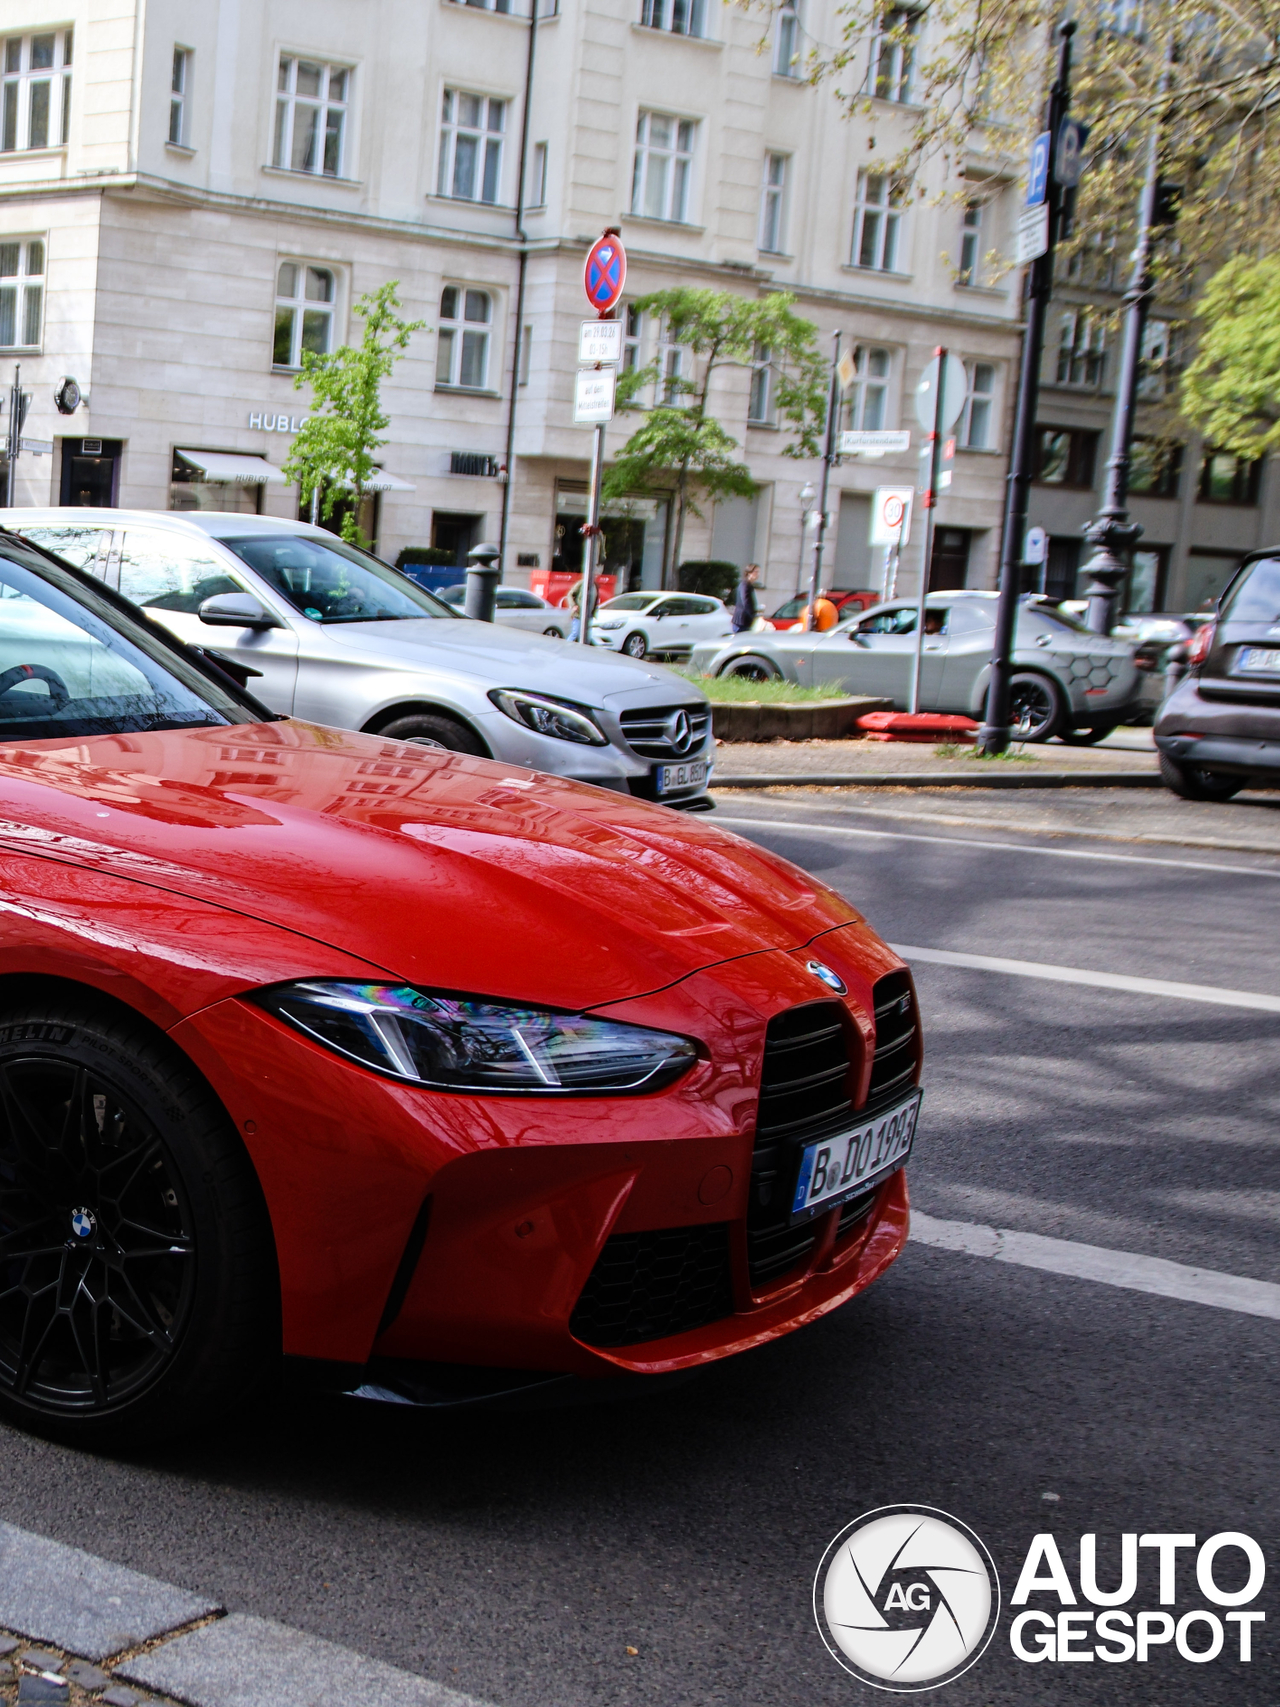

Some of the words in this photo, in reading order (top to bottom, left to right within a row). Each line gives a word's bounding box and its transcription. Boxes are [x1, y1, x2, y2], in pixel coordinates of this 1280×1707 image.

[1030, 143, 1045, 197] P
[249, 413, 311, 433] HUBL
[235, 474, 270, 483] HUBLOT
[887, 503, 901, 518] 30
[664, 768, 671, 787] B
[677, 766, 689, 785] GL
[81, 1034, 116, 1057] PILOT
[117, 1055, 155, 1087] SPORT
[810, 1145, 832, 1199] B
[870, 1100, 918, 1170] 1993
[71, 1206, 96, 1224] BMW
